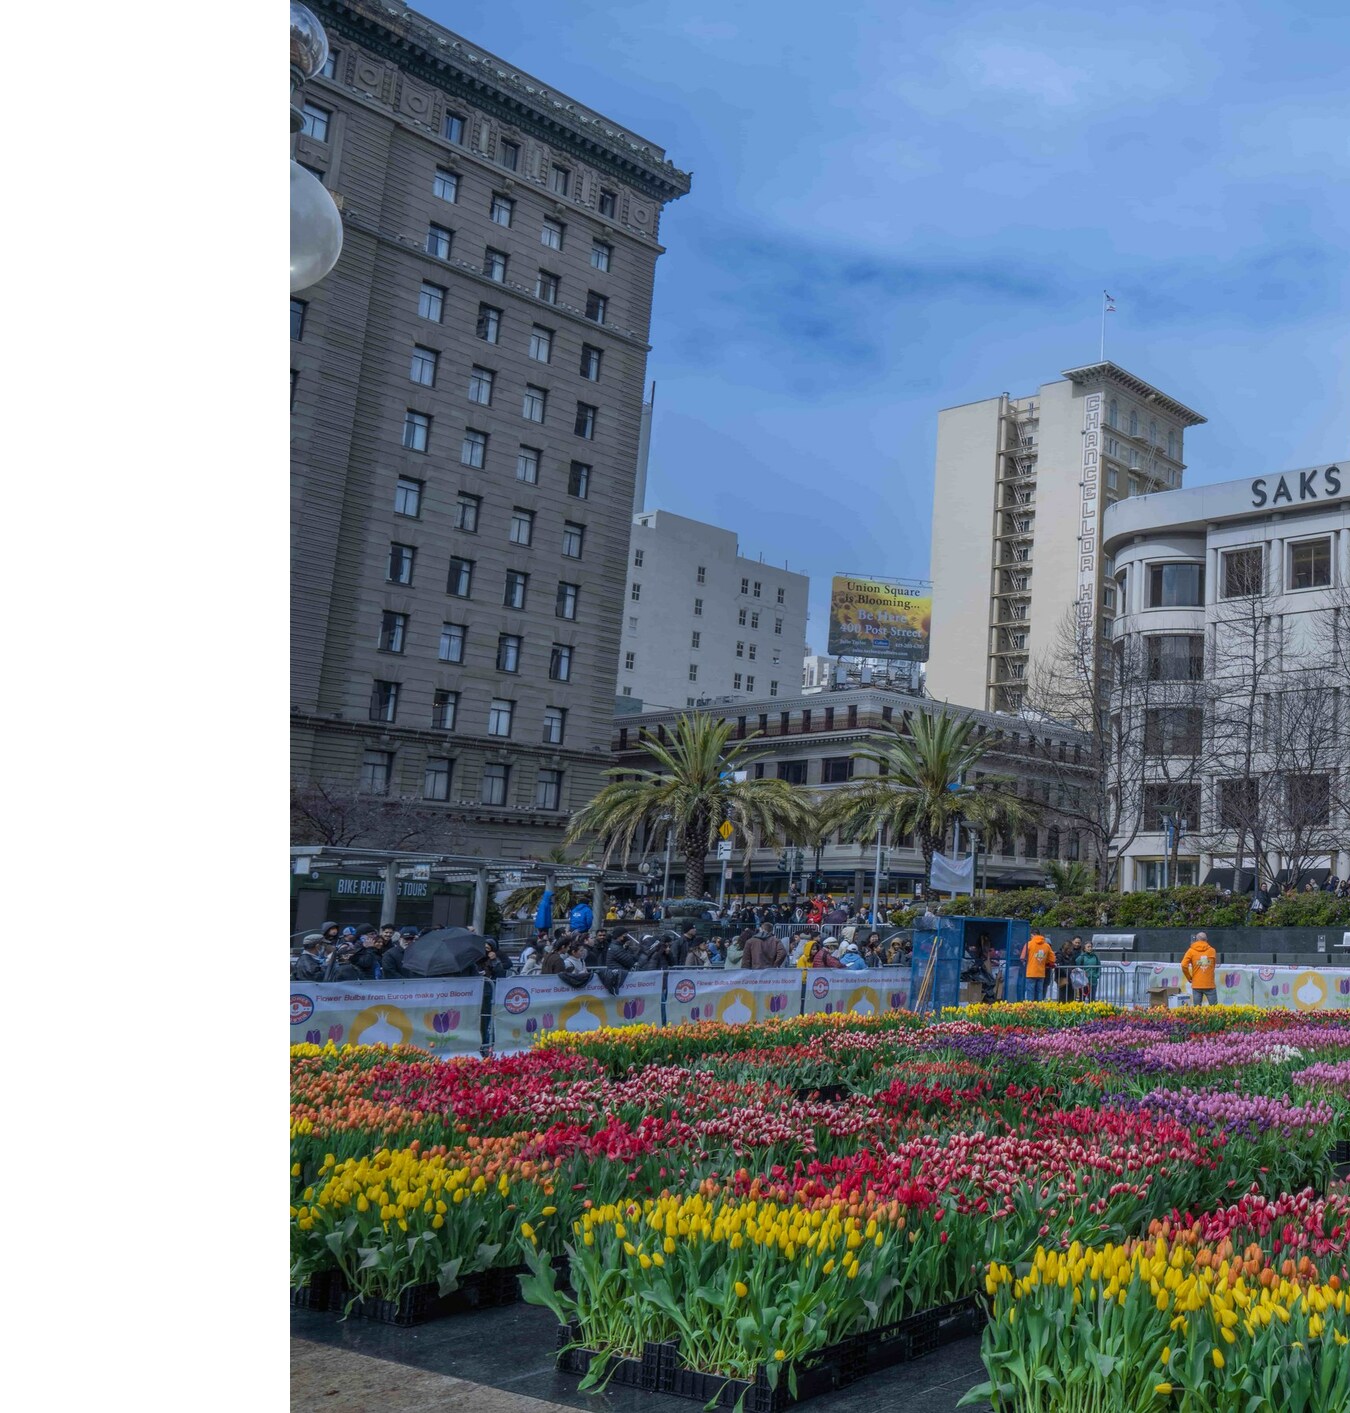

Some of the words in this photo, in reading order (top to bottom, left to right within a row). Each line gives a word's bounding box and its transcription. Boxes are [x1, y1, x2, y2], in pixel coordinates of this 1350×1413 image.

[1080, 394, 1100, 573] CHANCELLOR
[1251, 465, 1342, 508] SAKS
[847, 581, 880, 594] Union
[884, 584, 920, 597] Square
[845, 594, 854, 603] is
[858, 594, 920, 610] Blooming...
[858, 609, 874, 621] Be
[878, 611, 908, 623] Here
[865, 624, 888, 635] Post
[890, 627, 922, 638] Street
[338, 879, 359, 894] BIKE
[360, 880, 386, 895] RENTA
[404, 883, 427, 896] TOURS
[450, 990, 474, 998] Bloom!
